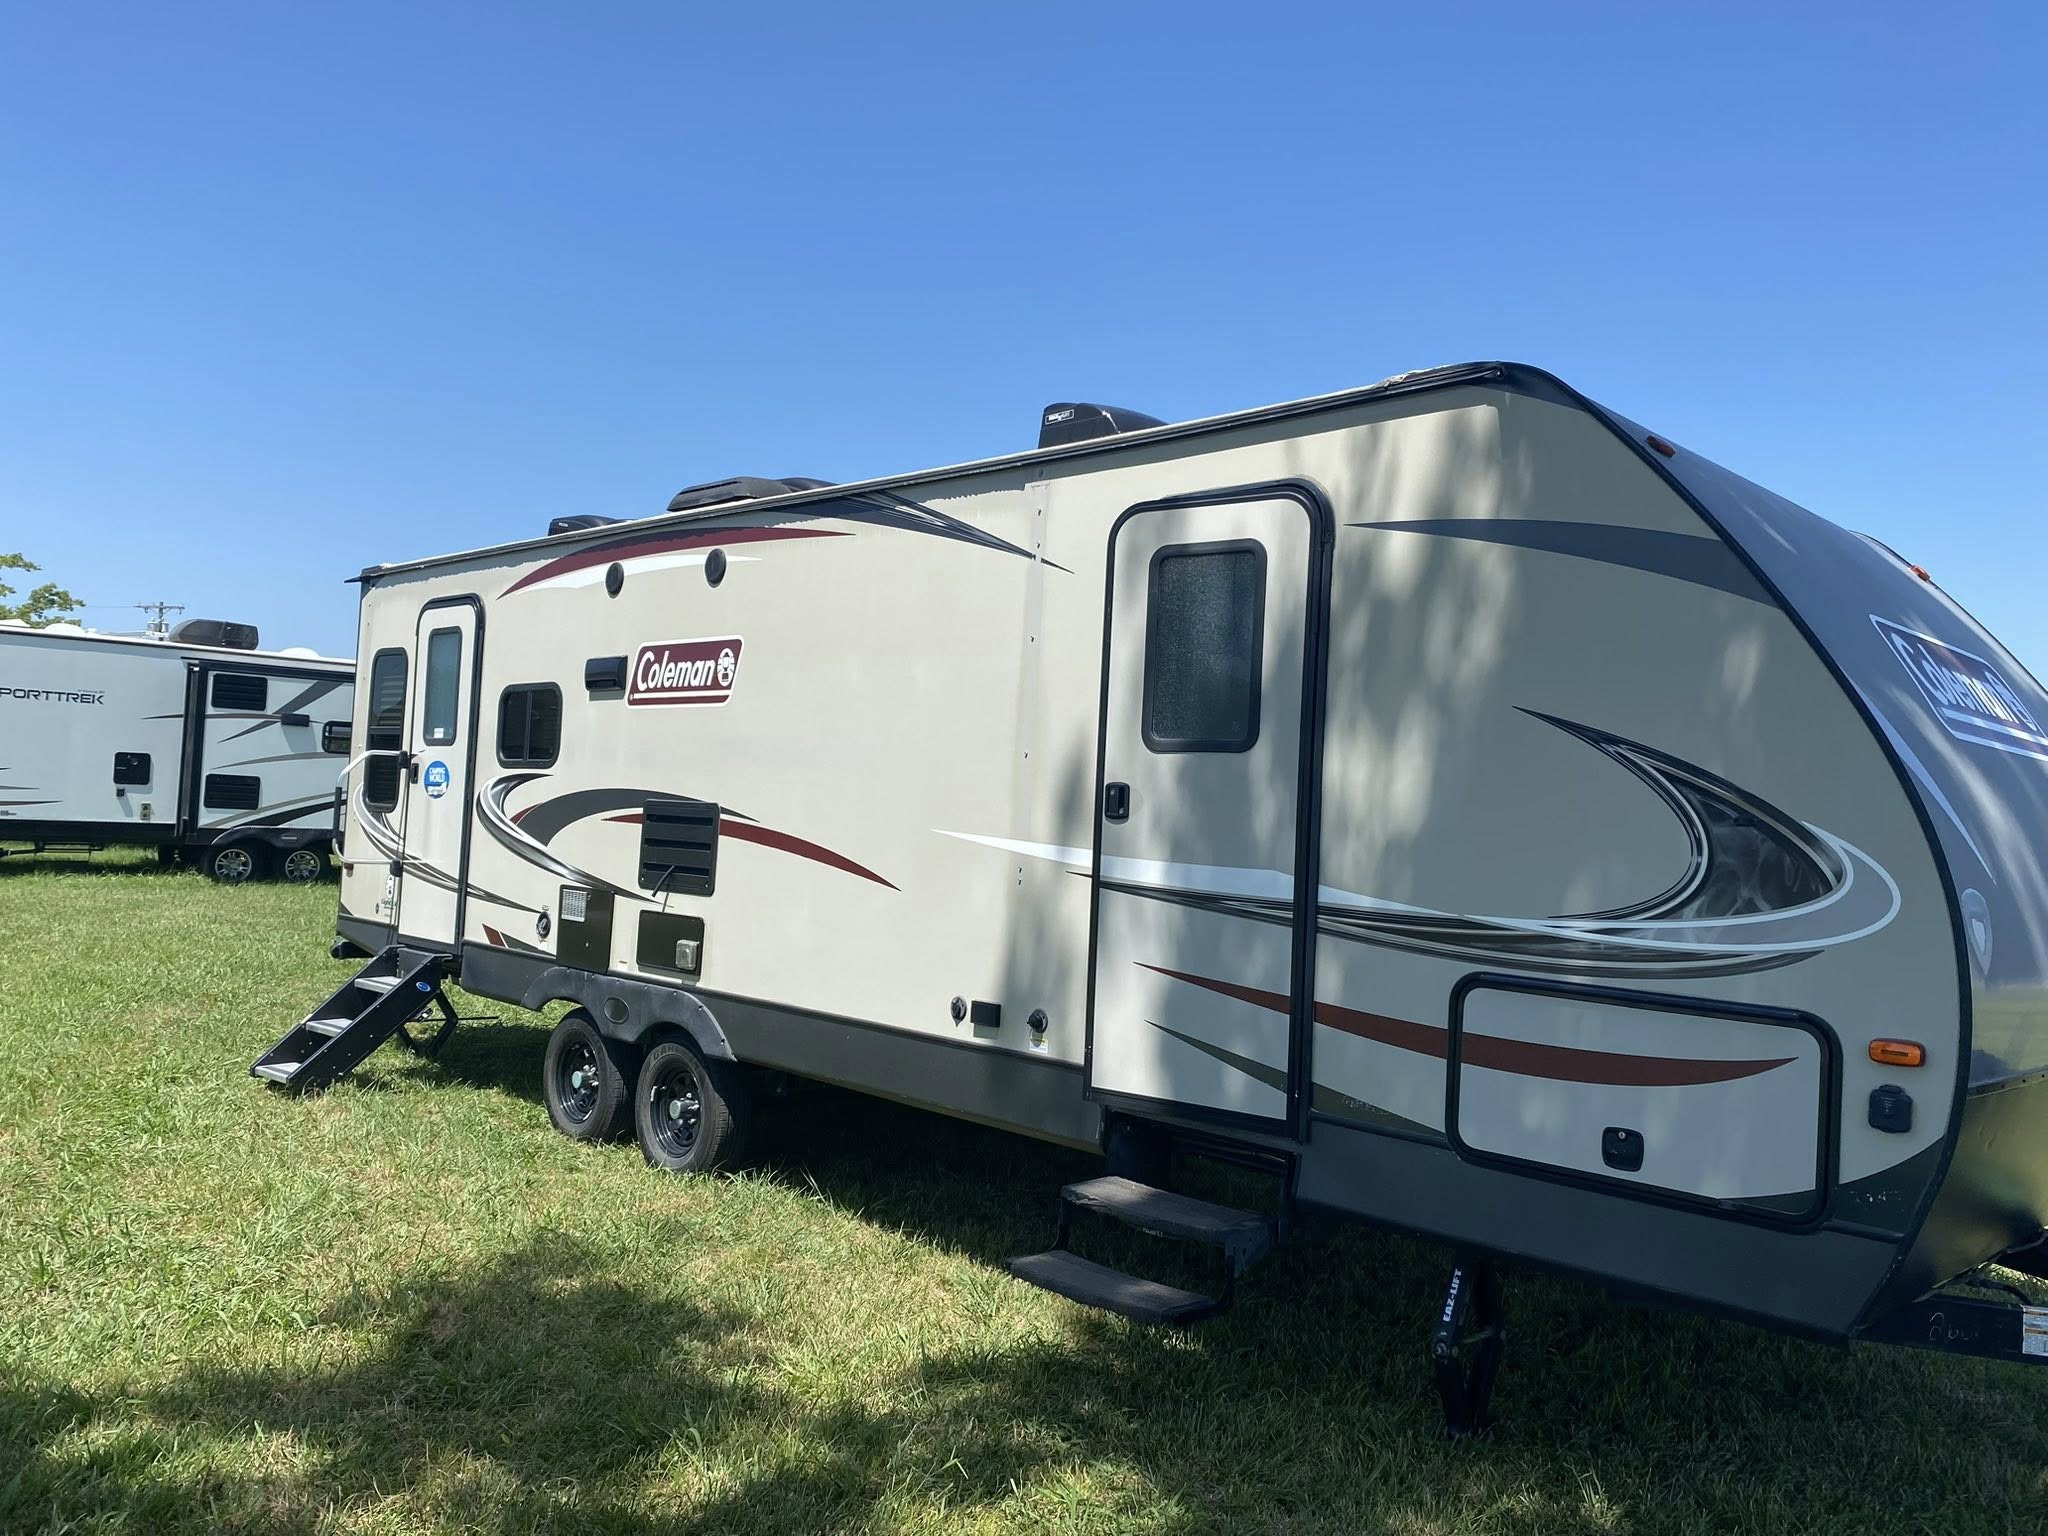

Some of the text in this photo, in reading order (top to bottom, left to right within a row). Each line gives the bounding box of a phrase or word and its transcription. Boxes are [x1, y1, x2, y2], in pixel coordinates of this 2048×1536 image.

[637, 650, 716, 692] Coleman
[1890, 632, 2021, 725] Coleman
[1442, 1268, 1463, 1323] EAZ-LIFT
